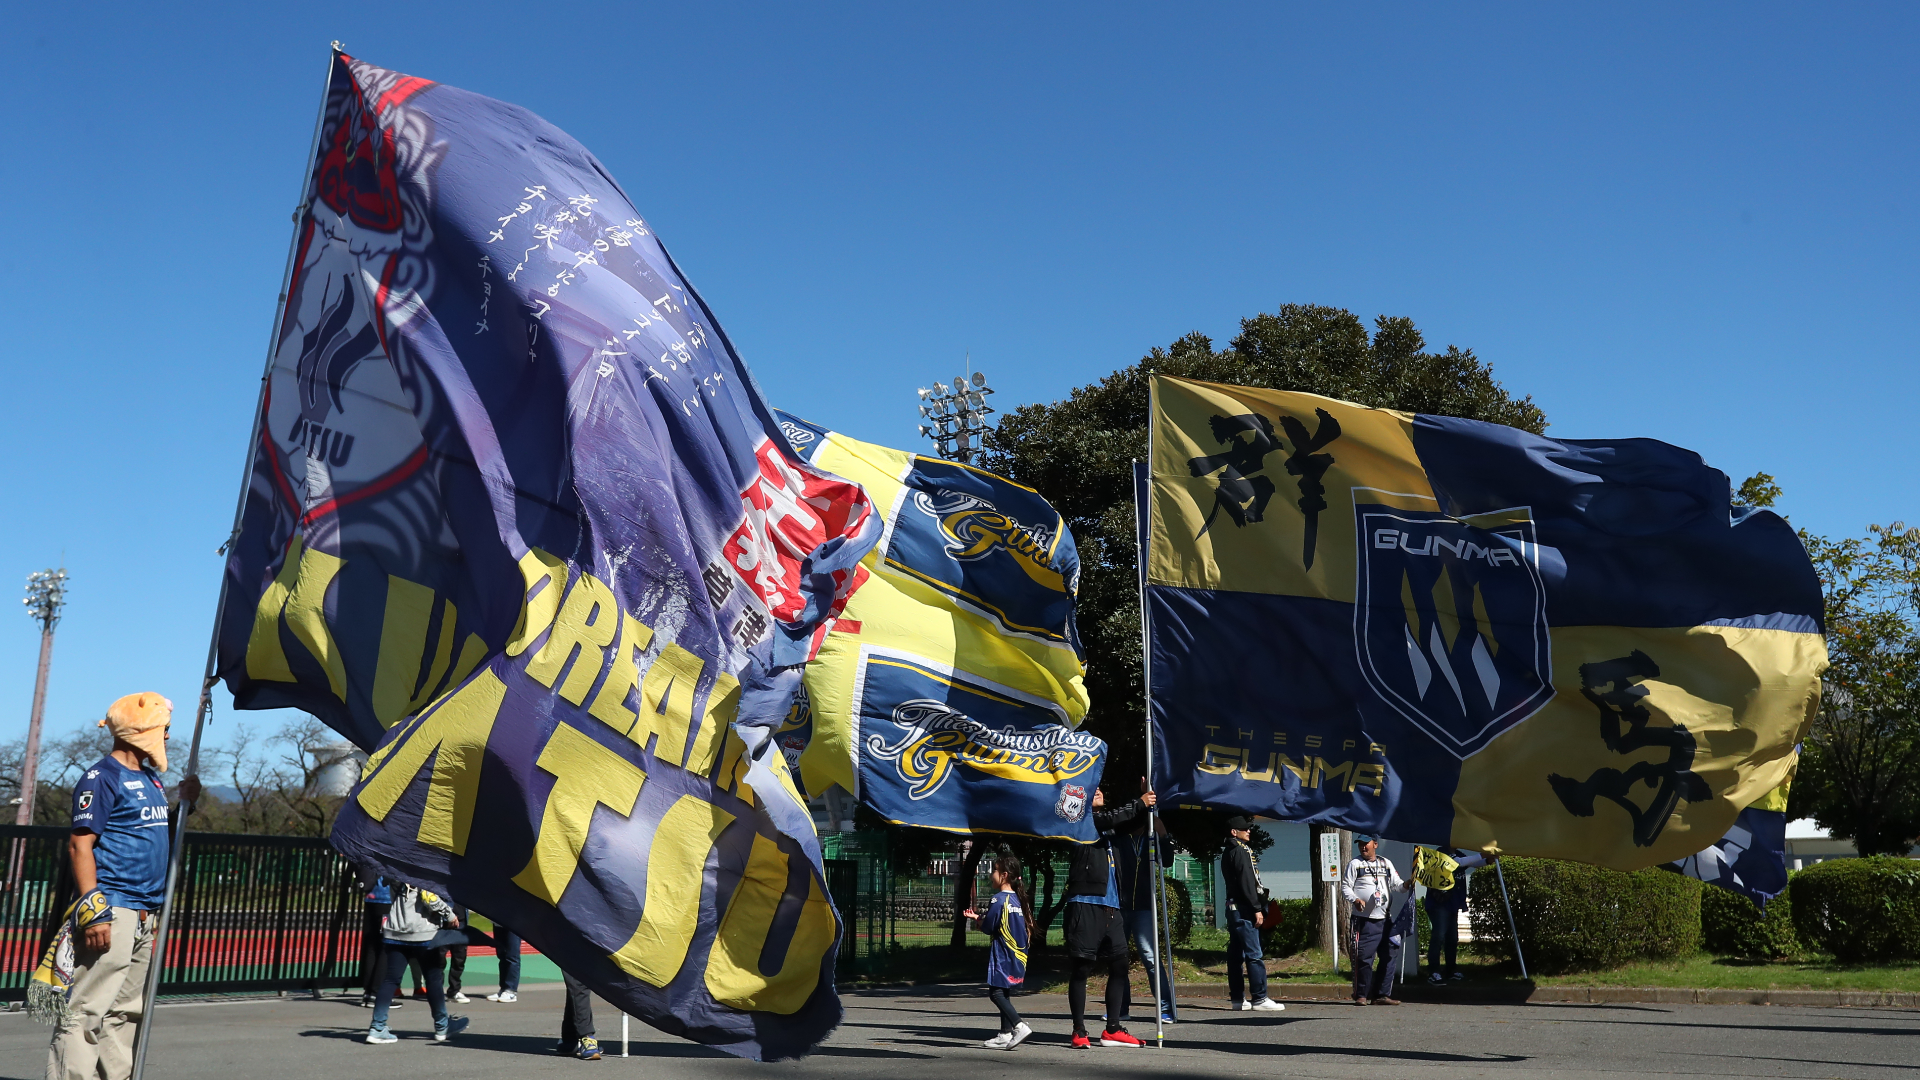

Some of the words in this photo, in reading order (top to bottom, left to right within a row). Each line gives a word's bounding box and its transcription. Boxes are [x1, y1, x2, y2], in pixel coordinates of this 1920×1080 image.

[1373, 528, 1521, 568] GUNMA
[1204, 724, 1388, 758] THESPA
[901, 730, 1101, 795] Gunma
[1197, 743, 1388, 798] GUNMA
[140, 805, 169, 822] CAIN
